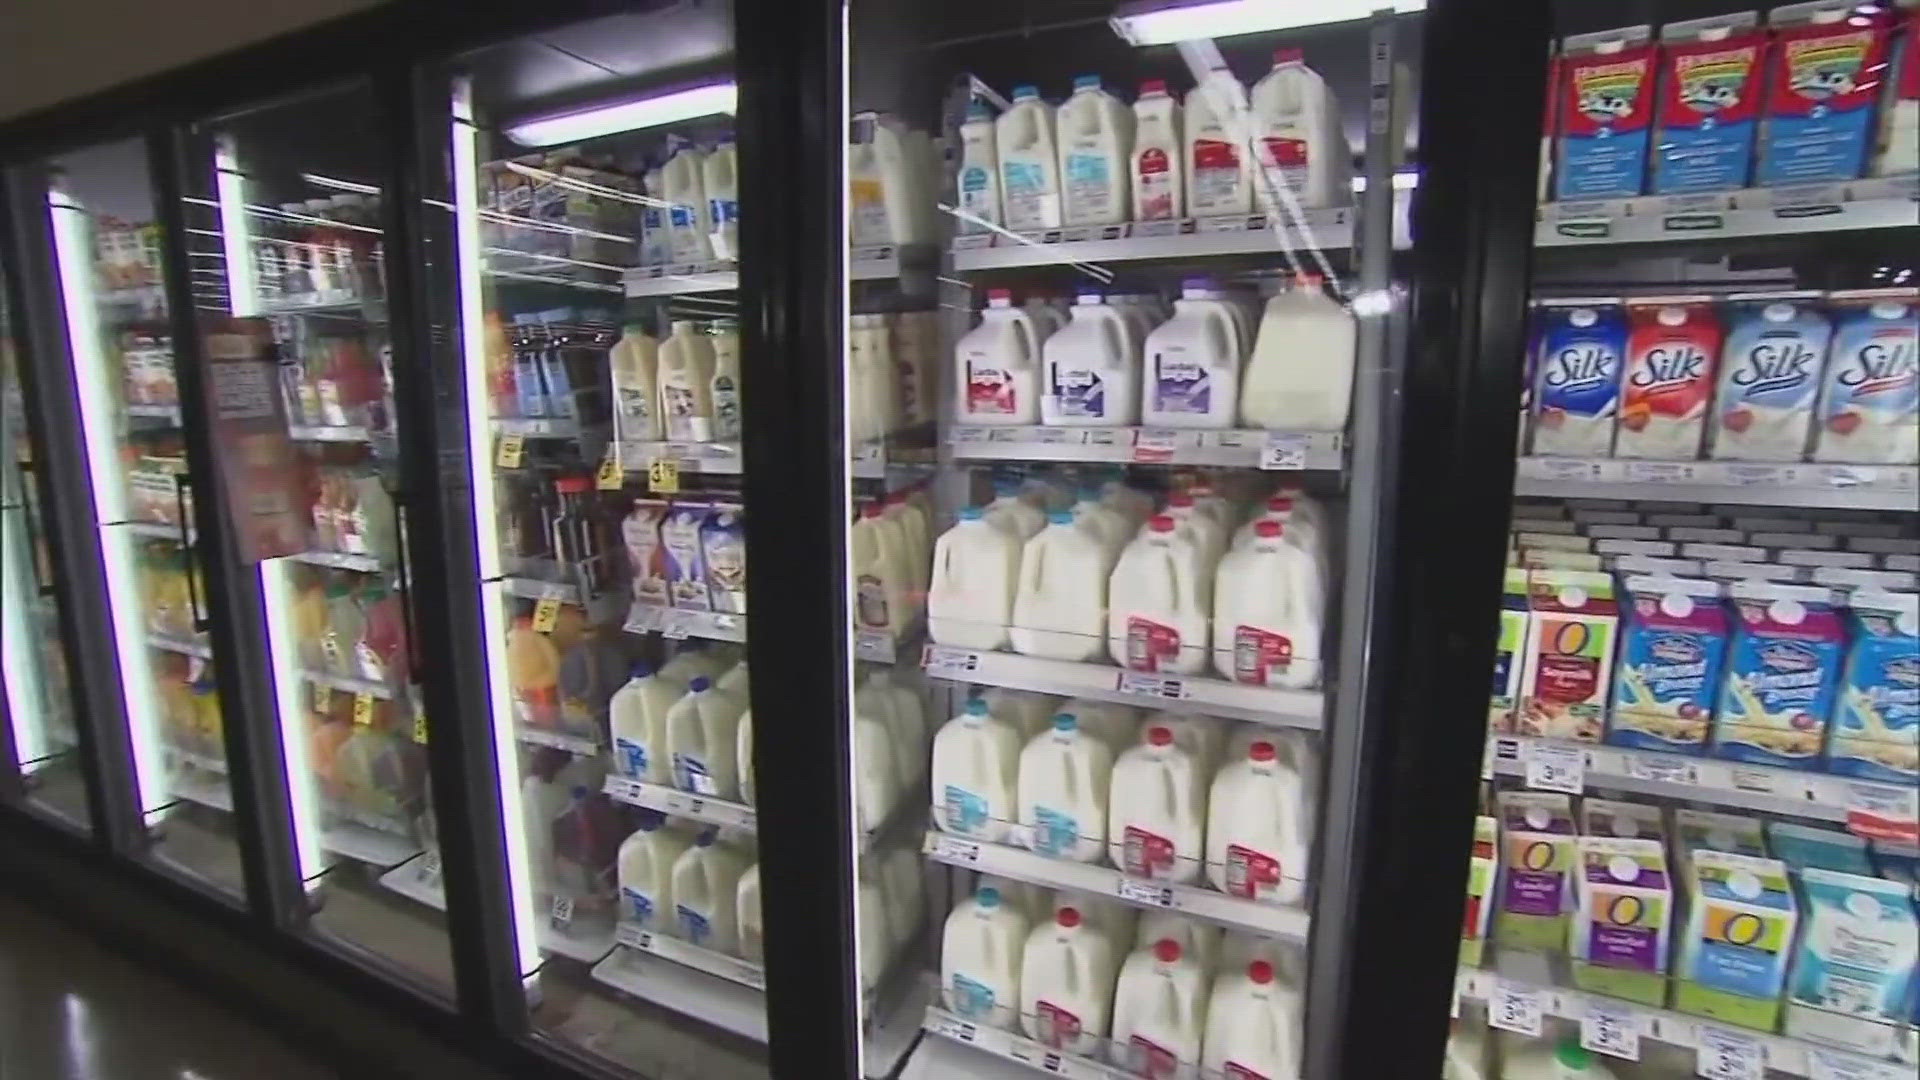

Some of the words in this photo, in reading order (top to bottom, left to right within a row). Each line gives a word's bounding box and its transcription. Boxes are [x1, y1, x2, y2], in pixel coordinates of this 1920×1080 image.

[1546, 346, 1614, 387] Silk
[1630, 347, 1705, 387] Silk
[1732, 344, 1815, 386] Silk
